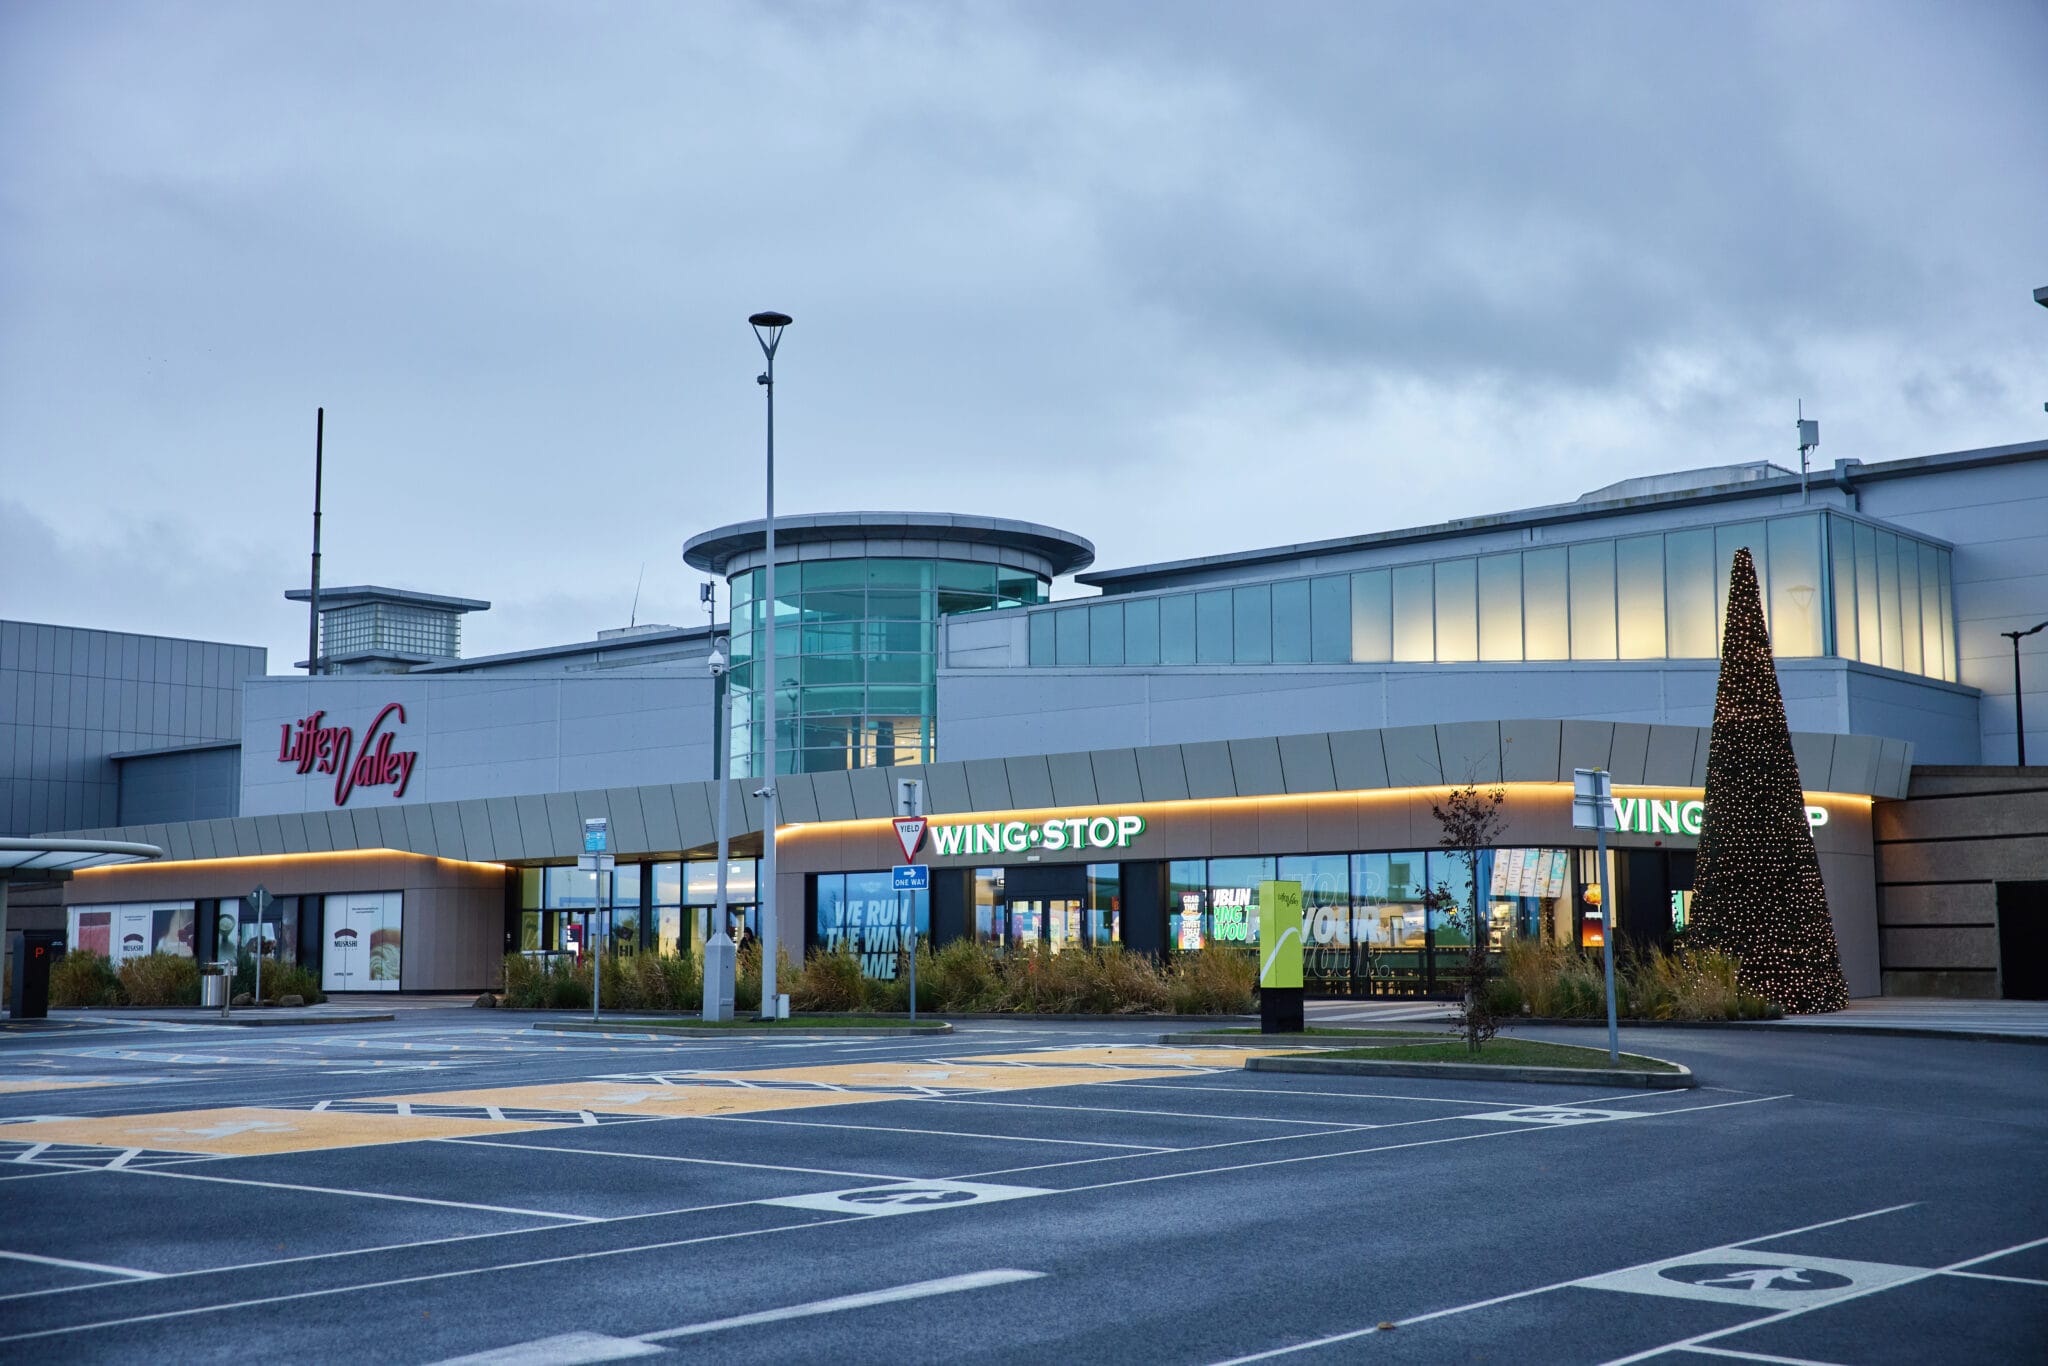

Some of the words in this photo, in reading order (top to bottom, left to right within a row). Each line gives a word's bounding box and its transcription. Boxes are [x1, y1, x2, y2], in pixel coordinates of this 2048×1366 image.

[278, 710, 343, 775] Liffey
[333, 702, 417, 806] Valley
[900, 825, 920, 833] YIELD
[911, 878, 926, 886] WAY
[835, 899, 863, 926] WE
[866, 899, 909, 926] RUN
[35, 947, 44, 959] P
[865, 926, 918, 953] WING
[857, 953, 898, 980] AME
